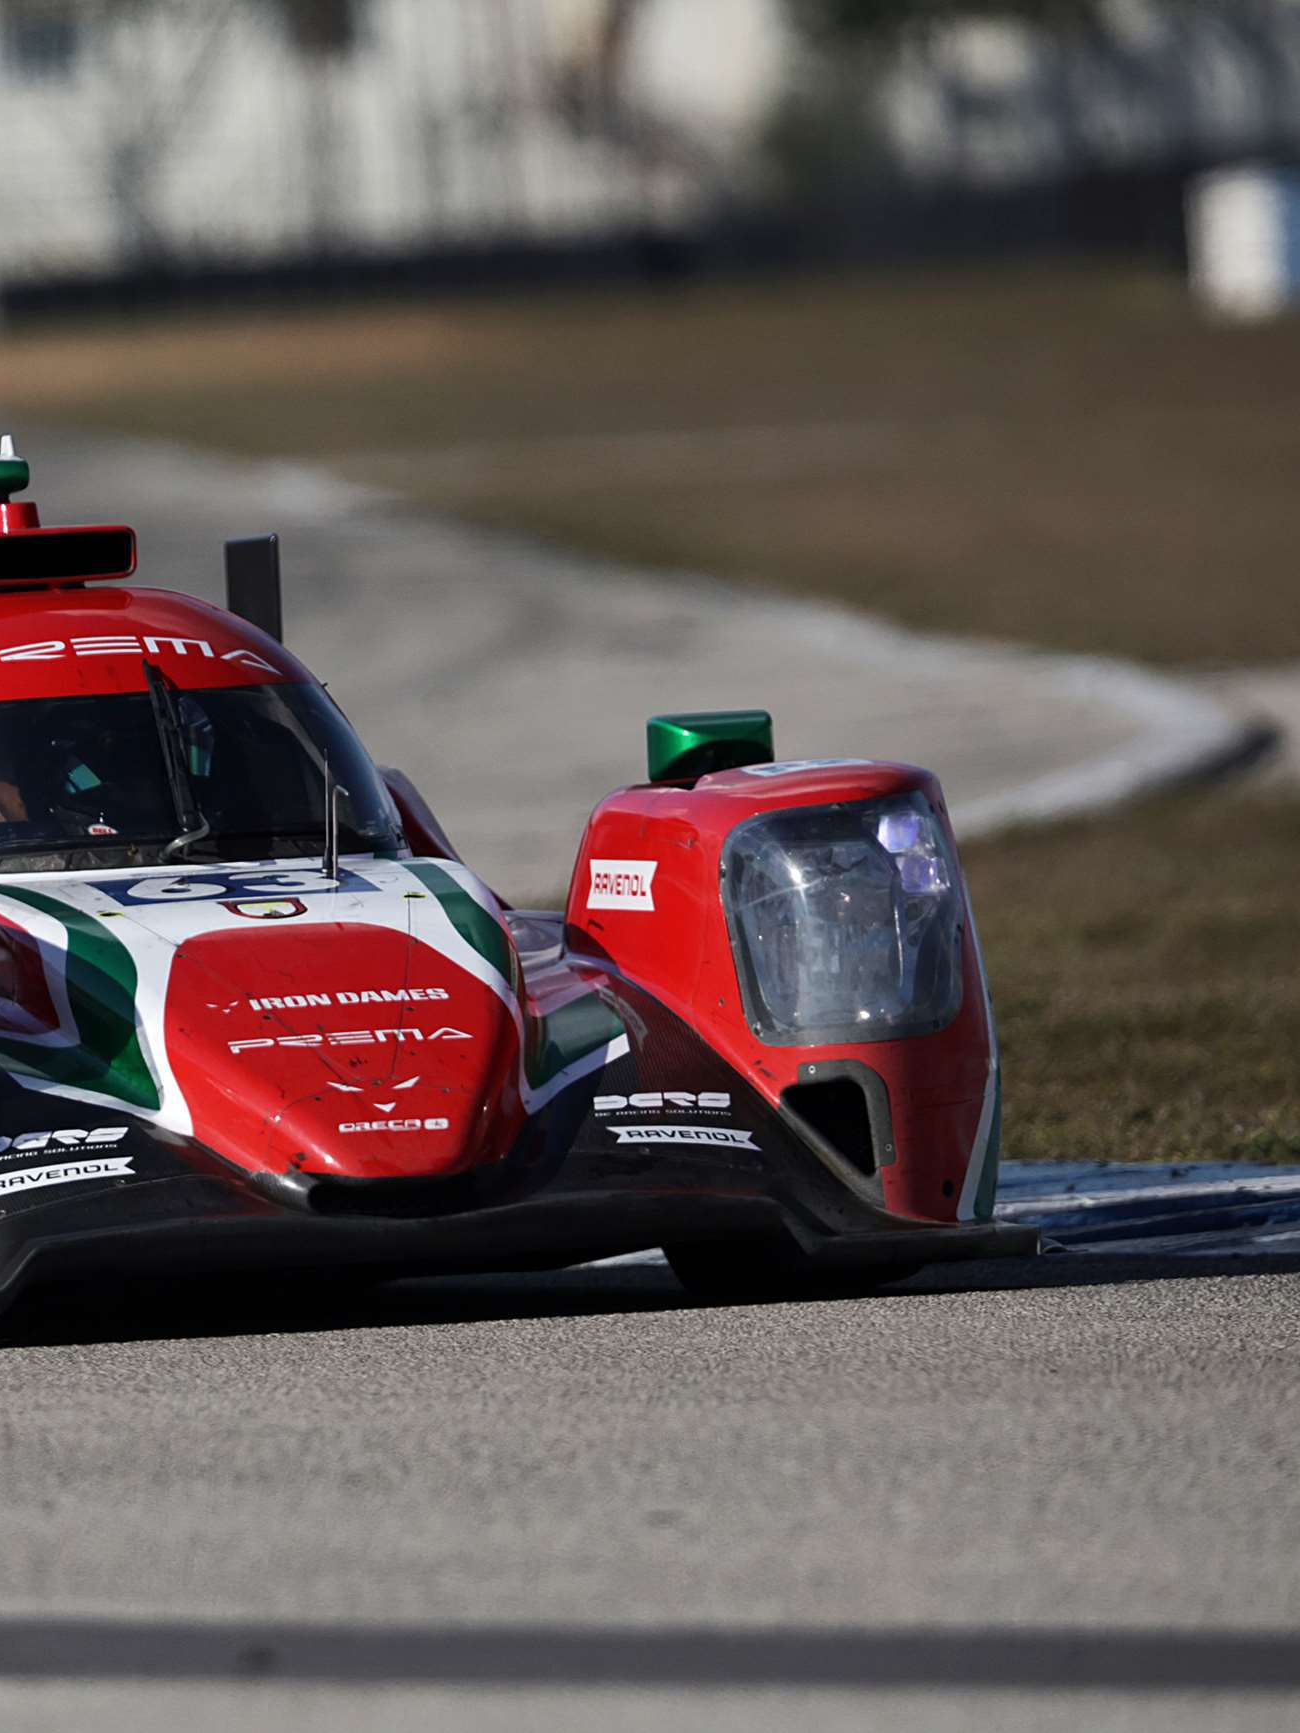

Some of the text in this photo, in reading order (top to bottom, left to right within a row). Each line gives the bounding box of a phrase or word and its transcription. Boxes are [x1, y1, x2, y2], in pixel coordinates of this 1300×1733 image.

[126, 870, 340, 899] 63
[594, 872, 647, 896] RAVENOL
[249, 987, 449, 1011] IRON DAMES
[227, 1026, 473, 1055] PREMA
[626, 1129, 746, 1144] RAVENOL
